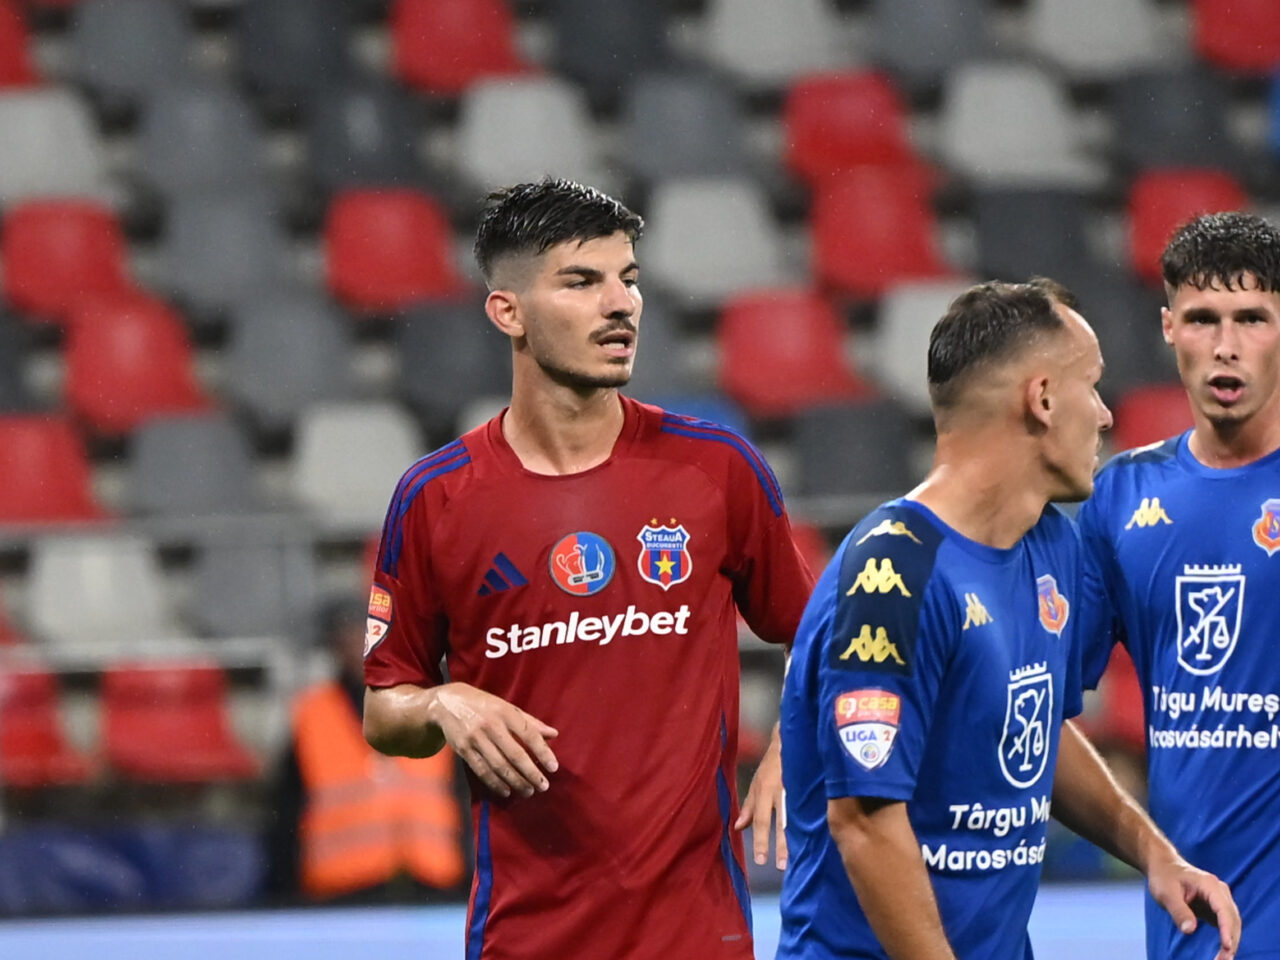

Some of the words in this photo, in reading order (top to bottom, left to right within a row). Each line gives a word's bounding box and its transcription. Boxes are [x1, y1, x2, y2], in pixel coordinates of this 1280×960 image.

[485, 605, 691, 659] Stanleybet
[845, 730, 878, 742] LIGA
[883, 729, 892, 742] 2
[949, 802, 1026, 837] Târgu
